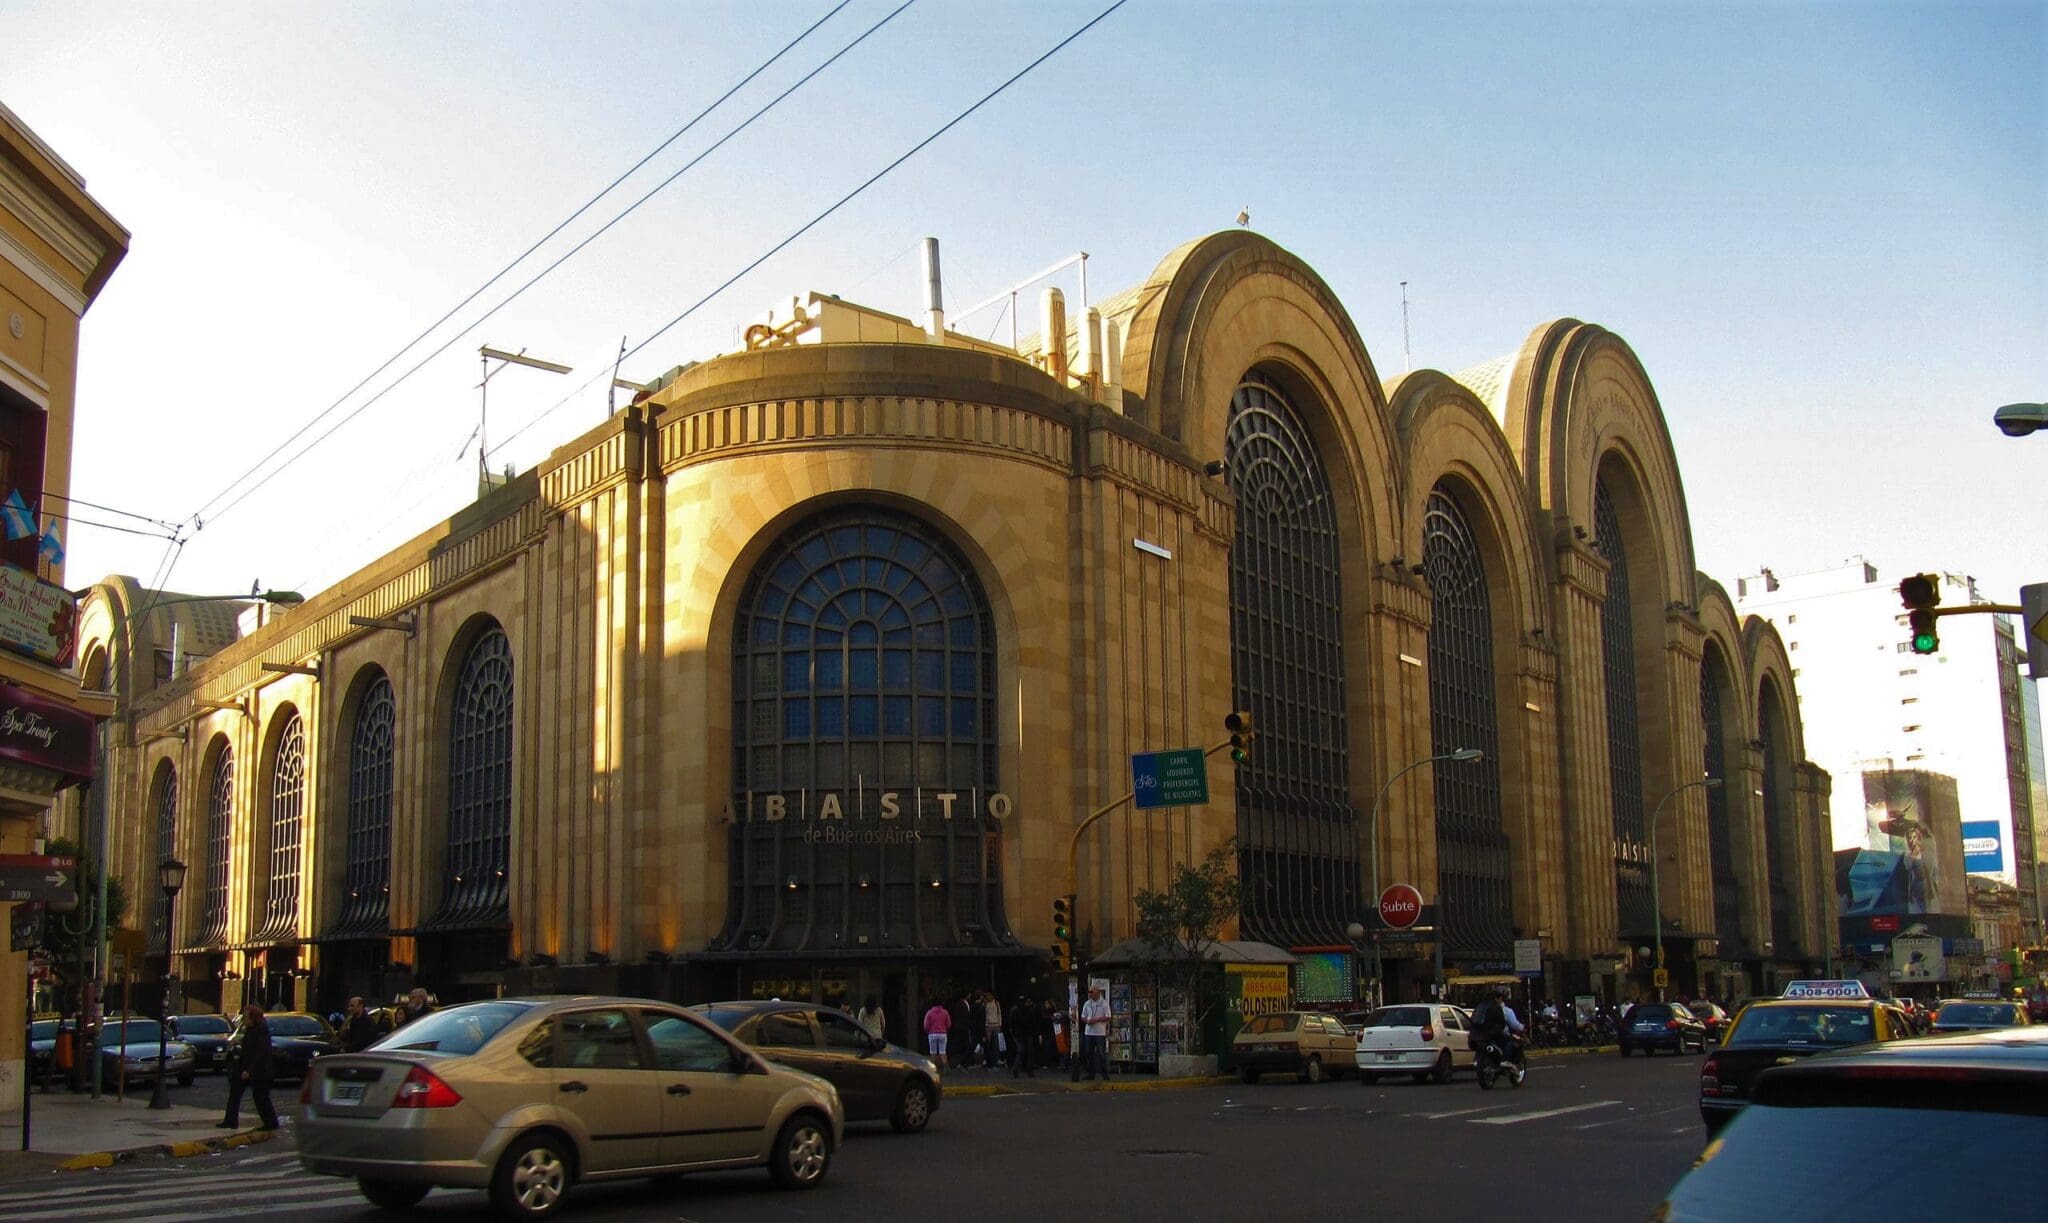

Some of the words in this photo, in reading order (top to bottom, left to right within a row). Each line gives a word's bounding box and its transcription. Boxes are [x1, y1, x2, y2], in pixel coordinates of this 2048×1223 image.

[804, 826, 821, 843] de
[826, 826, 880, 843] Buenos
[884, 826, 922, 843] Aires
[10, 890, 31, 899] 3300
[1382, 901, 1415, 912] Subte
[1789, 988, 1859, 996] 4308-0001
[1243, 996, 1287, 1015] OLDSTEIN
